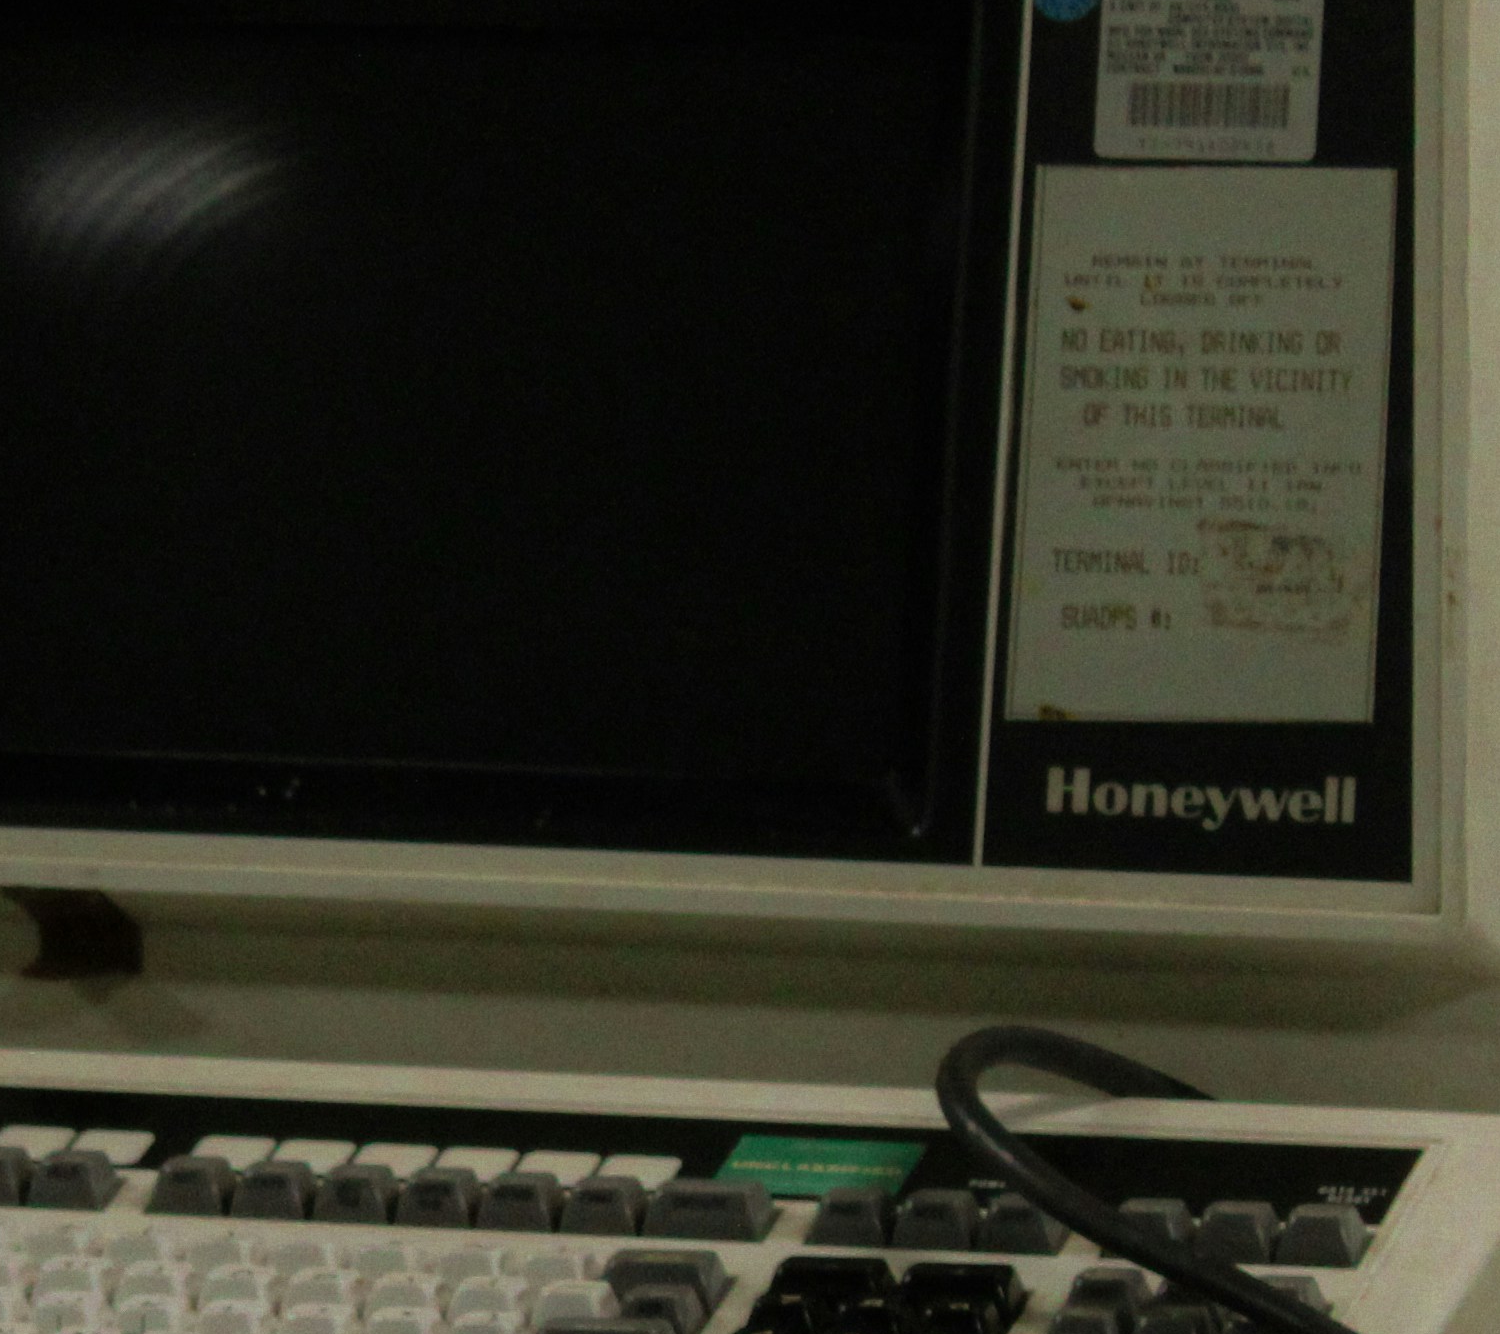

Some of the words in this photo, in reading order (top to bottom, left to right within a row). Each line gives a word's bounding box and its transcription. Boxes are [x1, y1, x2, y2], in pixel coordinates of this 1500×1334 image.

[1216, 273, 1343, 290] COMPLETELY
[1059, 328, 1088, 354] NO
[1099, 329, 1185, 357] EATING,
[1200, 329, 1304, 356] DRINKING
[1315, 330, 1342, 356] OR
[1059, 364, 1150, 391] SMOKING
[1163, 365, 1188, 391] IN
[1202, 366, 1239, 392] THE
[1250, 367, 1354, 394] VICINITY
[1081, 402, 1110, 427] OF
[1122, 403, 1174, 429] THIS
[1186, 403, 1285, 430] TERMINAL
[1052, 547, 1150, 577] TERMINAL
[1167, 549, 1200, 577] ID:
[1045, 766, 1357, 831] Honeywell
[730, 1159, 902, 1176] UNCLASSIFIED
